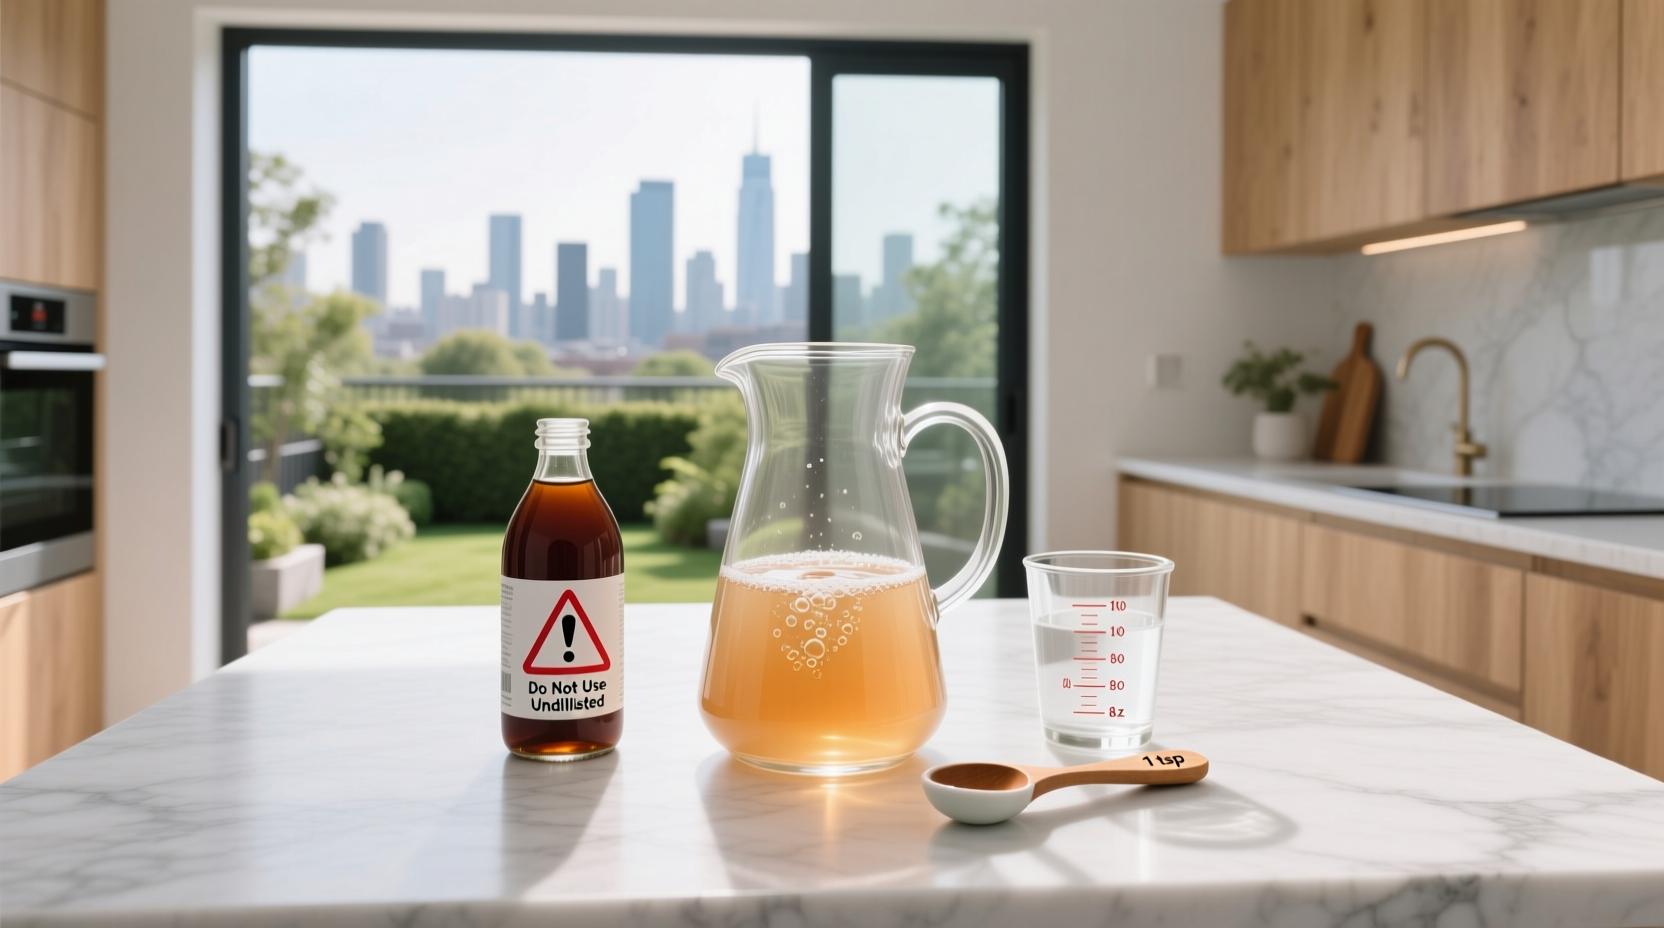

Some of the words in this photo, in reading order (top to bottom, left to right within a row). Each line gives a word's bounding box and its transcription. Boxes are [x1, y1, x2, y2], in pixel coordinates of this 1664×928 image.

[1110, 653, 1125, 664] 80
[528, 681, 547, 694] Do
[552, 681, 578, 695] Not
[582, 680, 607, 693] Use
[1109, 679, 1125, 691] 80
[1142, 756, 1154, 767] 1
[1155, 755, 1185, 767] tsp
